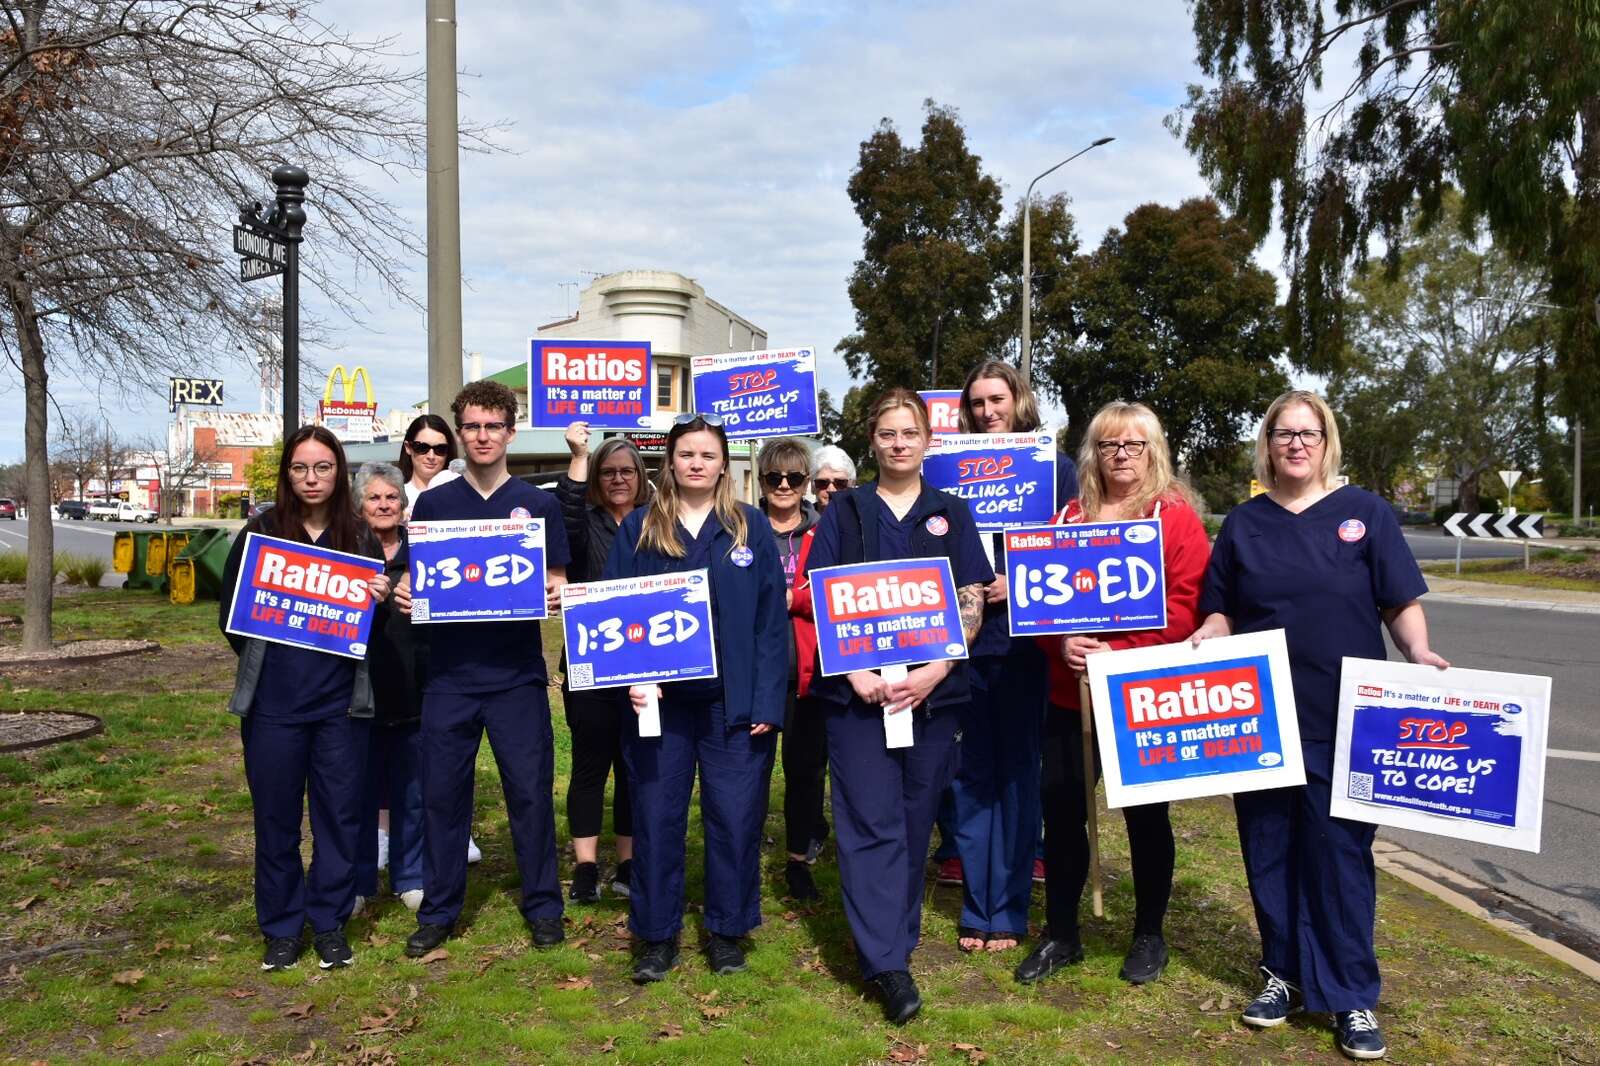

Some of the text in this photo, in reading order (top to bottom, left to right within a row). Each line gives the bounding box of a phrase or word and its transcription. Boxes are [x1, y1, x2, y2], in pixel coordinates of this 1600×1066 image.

[238, 229, 286, 264] HONOUR AVE
[547, 352, 642, 381] Ratios
[778, 351, 795, 359] DEATH
[175, 379, 223, 404] REX
[728, 369, 777, 390] STOP
[547, 387, 642, 400] It's a matter of
[712, 390, 799, 413] TELLING US
[323, 406, 374, 416] McDonald's
[547, 401, 643, 415] LIFE or DEATH
[721, 404, 788, 426] TO COPE!
[992, 437, 1005, 445] LIFE
[958, 455, 1013, 477] STOP
[1015, 481, 1037, 495] US
[975, 496, 1023, 514] COPE!
[479, 524, 492, 532] LIFE
[502, 523, 524, 531] DEATH
[1056, 530, 1070, 539] It's
[1079, 528, 1108, 538] matter
[1110, 527, 1119, 536] of
[1010, 535, 1052, 548] Ratios
[1078, 539, 1088, 547] or
[259, 552, 368, 603] Ratios
[415, 553, 535, 592] 1:3 IN ED
[605, 584, 628, 592] matter
[639, 580, 654, 589] LIFE
[664, 577, 686, 586] DEATH
[1015, 556, 1156, 608] 1:3 in ED
[254, 590, 363, 625] It's a matter of
[830, 576, 941, 615] Ratios
[251, 605, 360, 640] LIFE or DEATH
[577, 609, 700, 656] 1:3 IN ED
[836, 612, 945, 639] It's a matter of
[838, 628, 949, 656] LIFE or DEATH
[1129, 680, 1255, 723] Ratios
[1384, 689, 1396, 698] It's
[1404, 692, 1430, 703] matter
[1432, 694, 1441, 703] of
[1444, 697, 1461, 706] LIFE
[1463, 699, 1472, 707] or
[1473, 700, 1500, 711] DEATH
[1135, 718, 1258, 747] It's a matter of
[1399, 718, 1468, 743] STOP
[1138, 735, 1263, 767] LIFE or DEATH
[1372, 749, 1496, 775] TELLING US
[1381, 770, 1476, 795] TO COPE!
